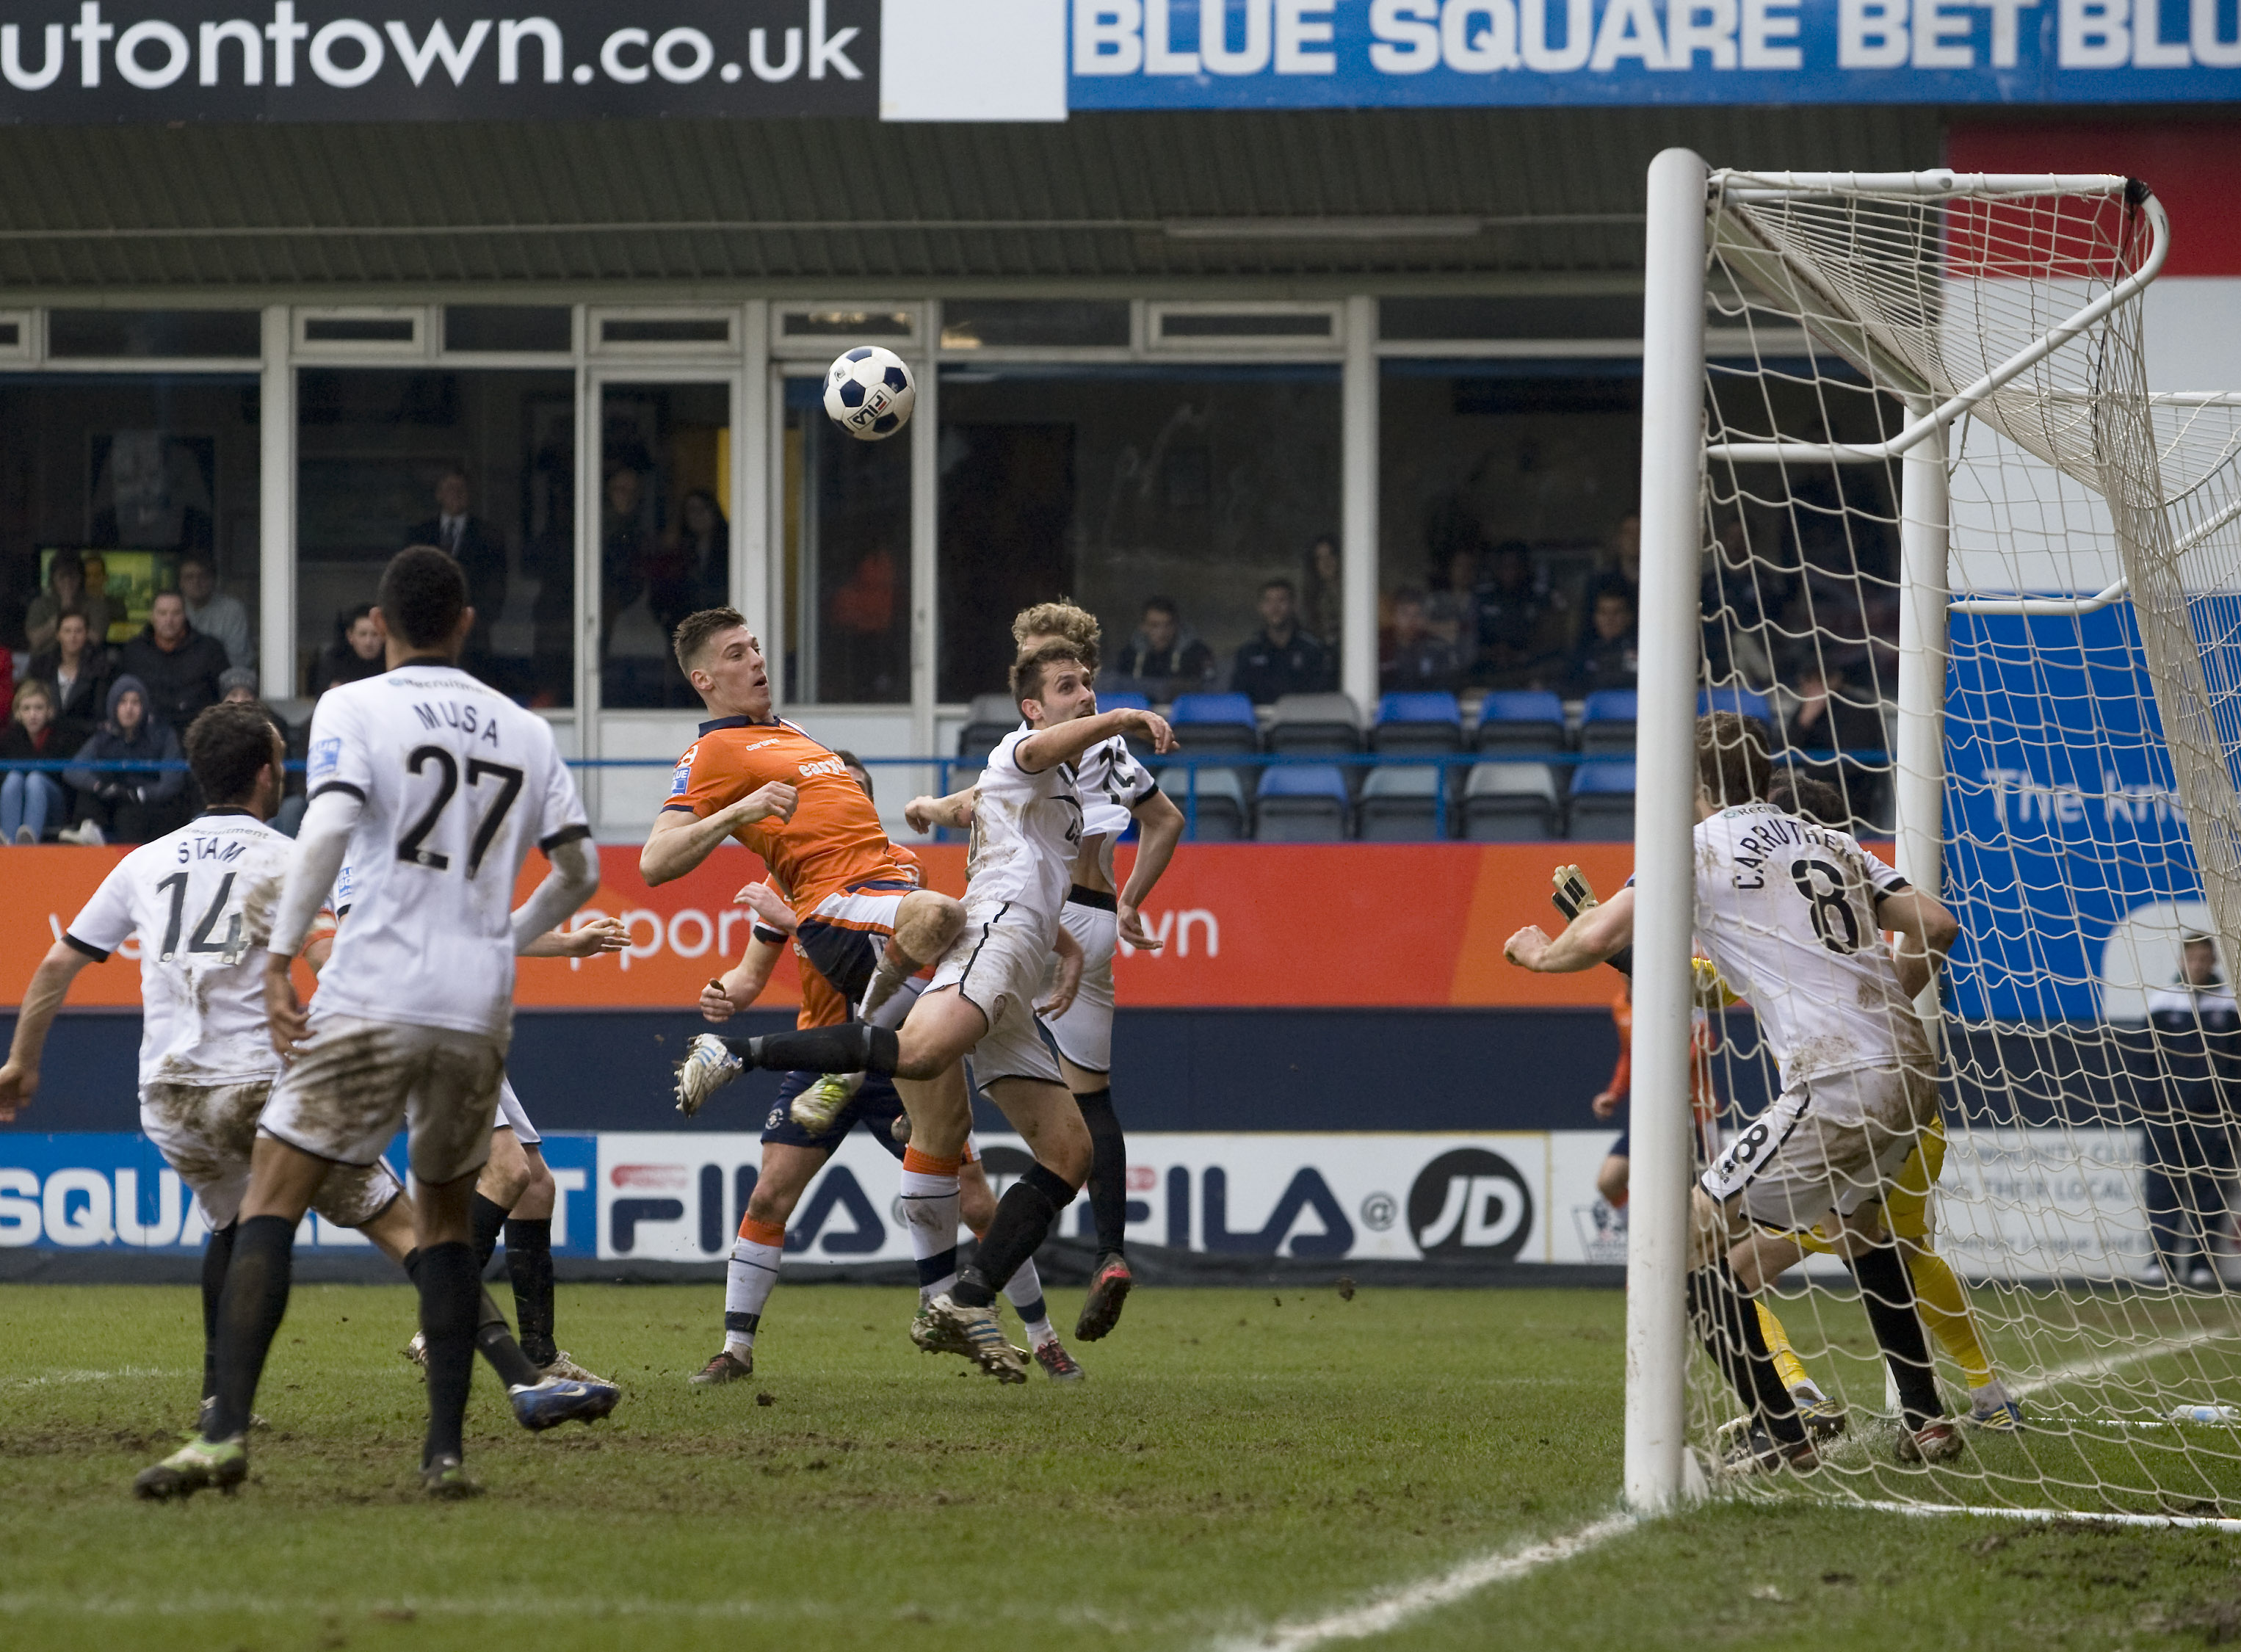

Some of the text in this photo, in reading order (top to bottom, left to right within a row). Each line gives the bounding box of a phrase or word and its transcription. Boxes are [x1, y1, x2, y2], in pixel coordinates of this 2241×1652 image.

[1, 0, 864, 91] utontown.co.uk
[1073, 0, 1336, 76] BLUE
[1369, 0, 1803, 73] SQUARE
[1837, 0, 2038, 69] BET
[852, 394, 887, 425] FILA
[413, 700, 498, 748] MUSA
[397, 745, 524, 881] 27
[1981, 769, 2084, 824] The
[178, 837, 247, 864] STAM
[156, 872, 251, 965] 14
[1791, 859, 1859, 955] 8
[1731, 1124, 1769, 1165] 8
[1419, 1176, 1525, 1247] JD
